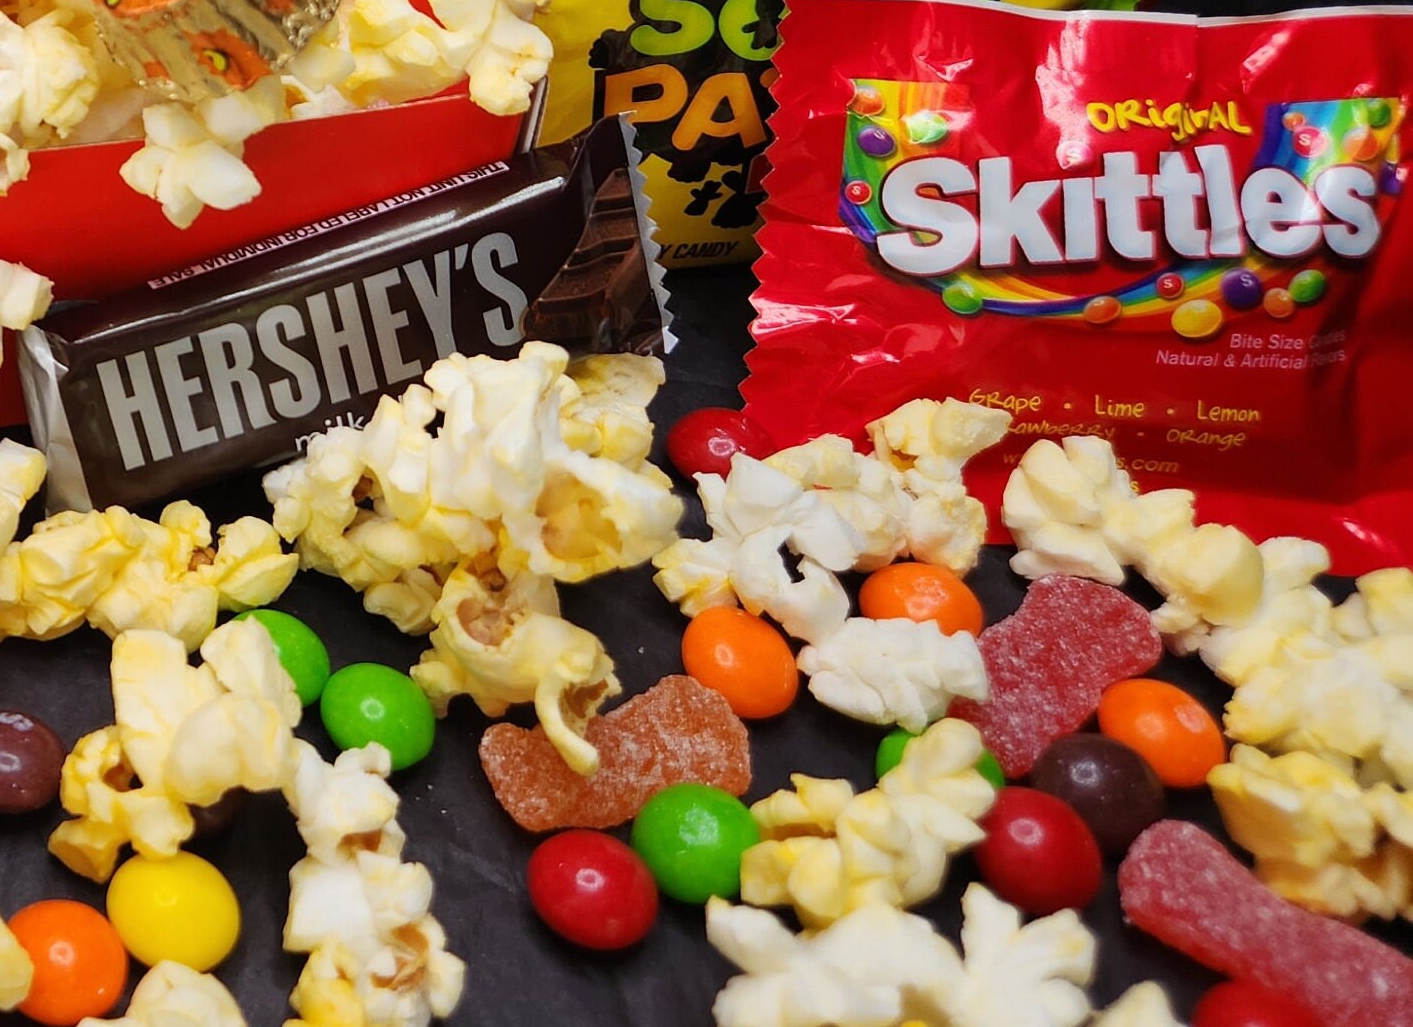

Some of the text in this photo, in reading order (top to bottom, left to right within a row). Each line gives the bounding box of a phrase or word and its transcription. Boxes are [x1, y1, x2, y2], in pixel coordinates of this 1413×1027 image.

[876, 144, 1383, 275] Skittles
[672, 240, 740, 260] CANDY
[96, 231, 531, 472] HERSHEY'S
[1229, 333, 1264, 349] Bite
[1267, 333, 1305, 350] Size
[1155, 349, 1219, 367] Natural
[1223, 353, 1236, 367] &
[1239, 353, 1308, 370] Artificial
[1094, 394, 1146, 418] Lime
[1196, 399, 1262, 424] Lemon
